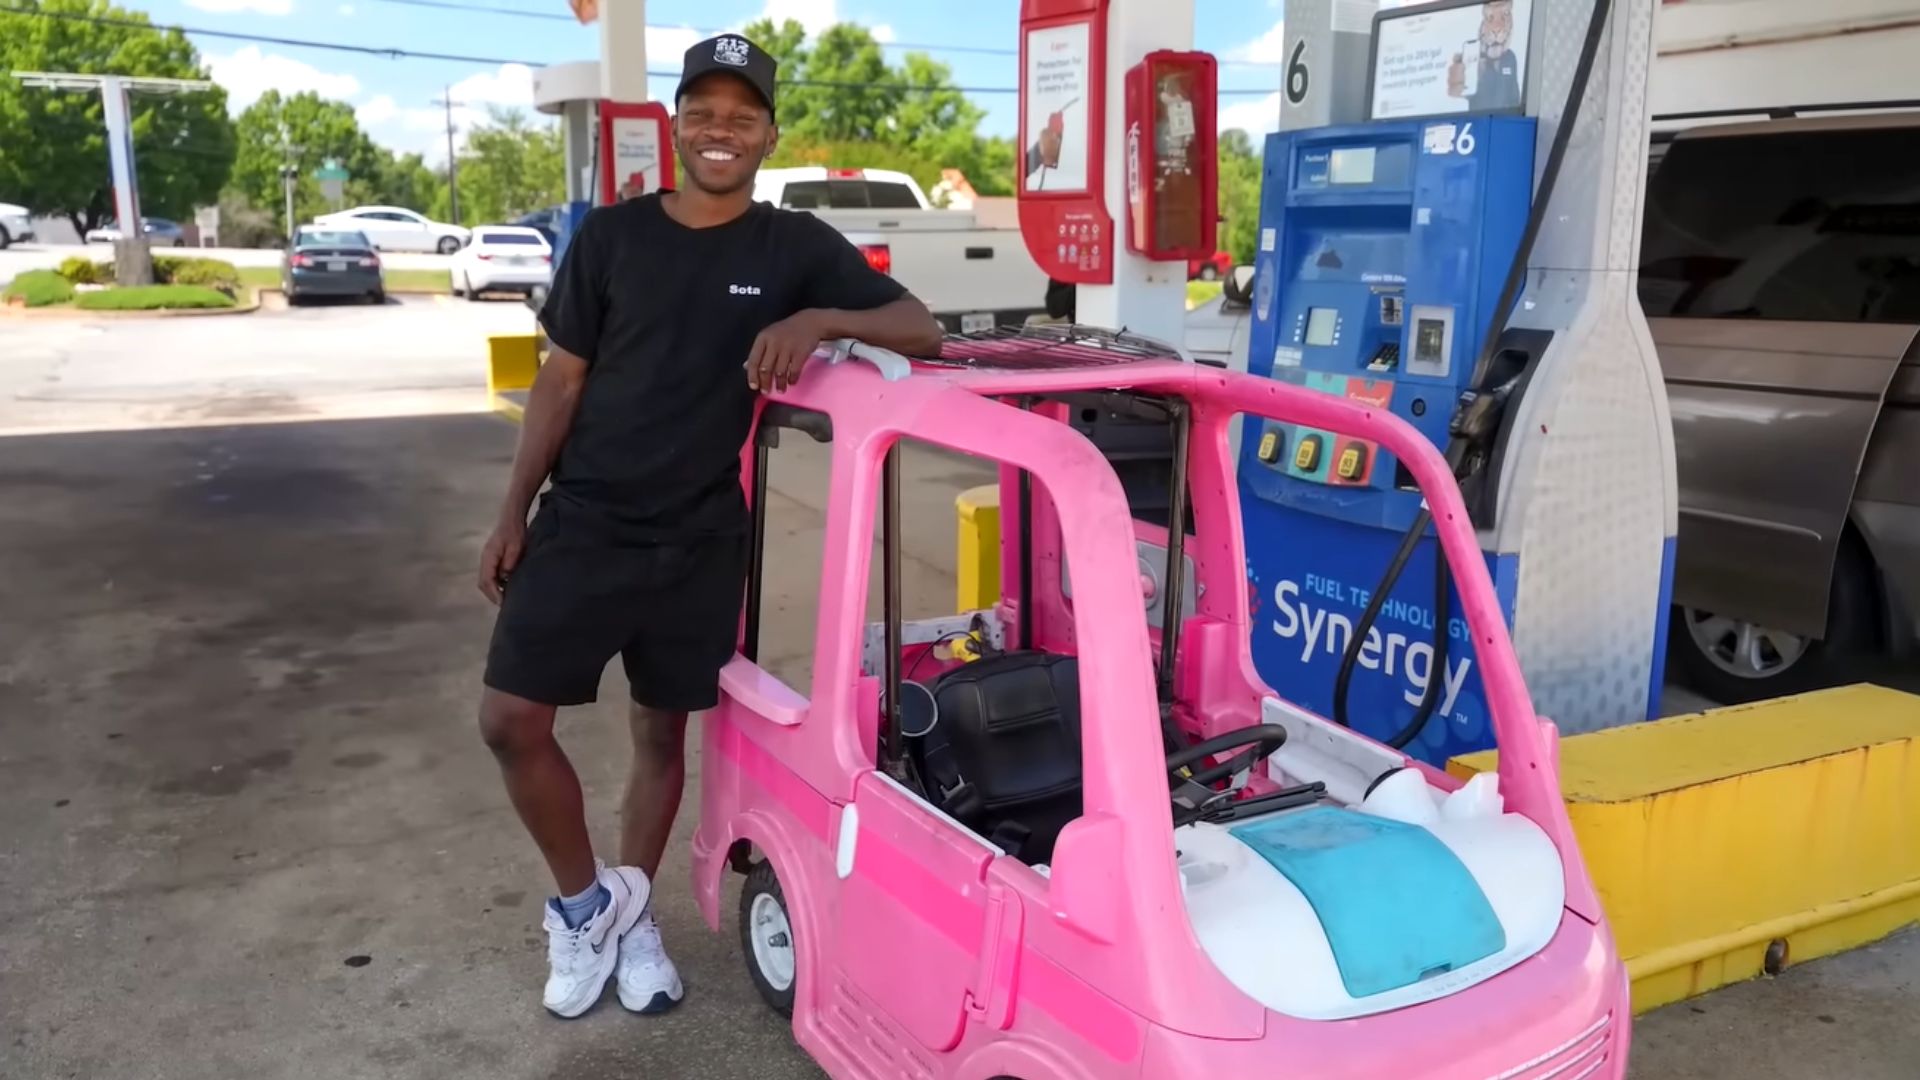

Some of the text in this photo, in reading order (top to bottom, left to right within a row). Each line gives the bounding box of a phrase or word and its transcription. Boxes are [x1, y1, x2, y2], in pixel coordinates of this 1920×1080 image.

[1286, 39, 1308, 104] 6
[1456, 122, 1475, 155] 6
[729, 284, 761, 295] Sota
[1305, 573, 1471, 642] FUEL TEHNOLGY
[1273, 579, 1472, 718] Synergy
